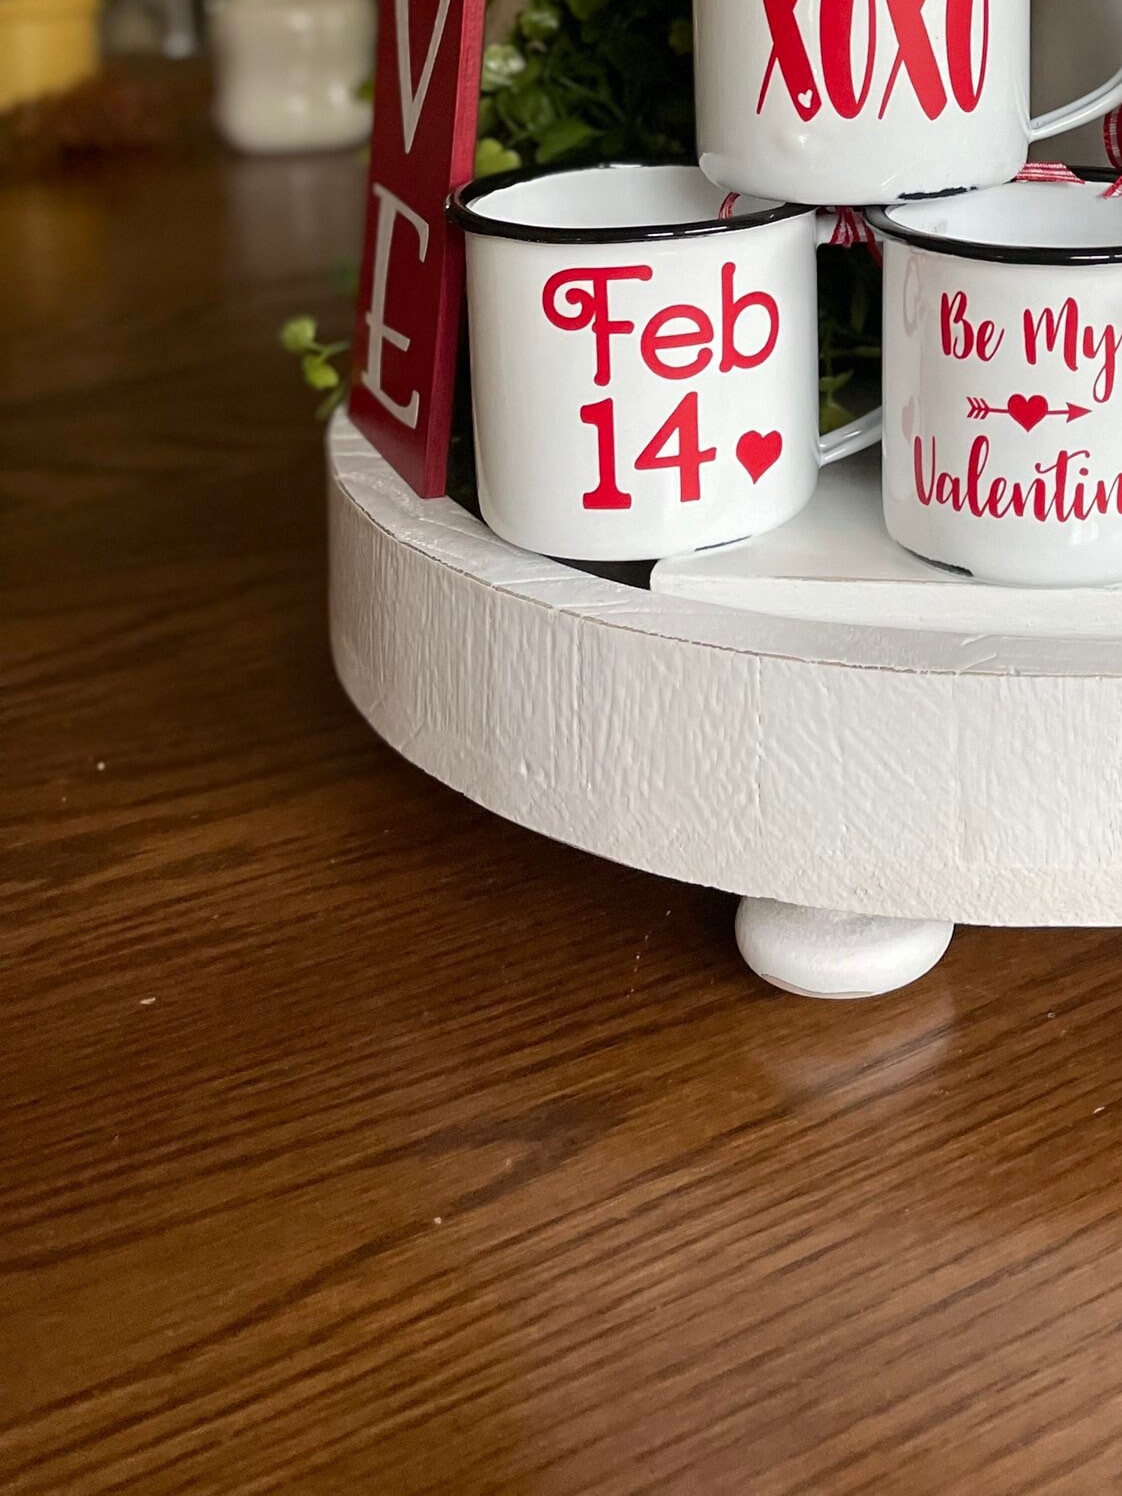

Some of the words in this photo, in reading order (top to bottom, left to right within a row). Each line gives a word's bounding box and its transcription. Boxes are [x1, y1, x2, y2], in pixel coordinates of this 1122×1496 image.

[542, 261, 779, 386] Feb
[940, 291, 1004, 360] Be
[578, 391, 717, 510] 14
